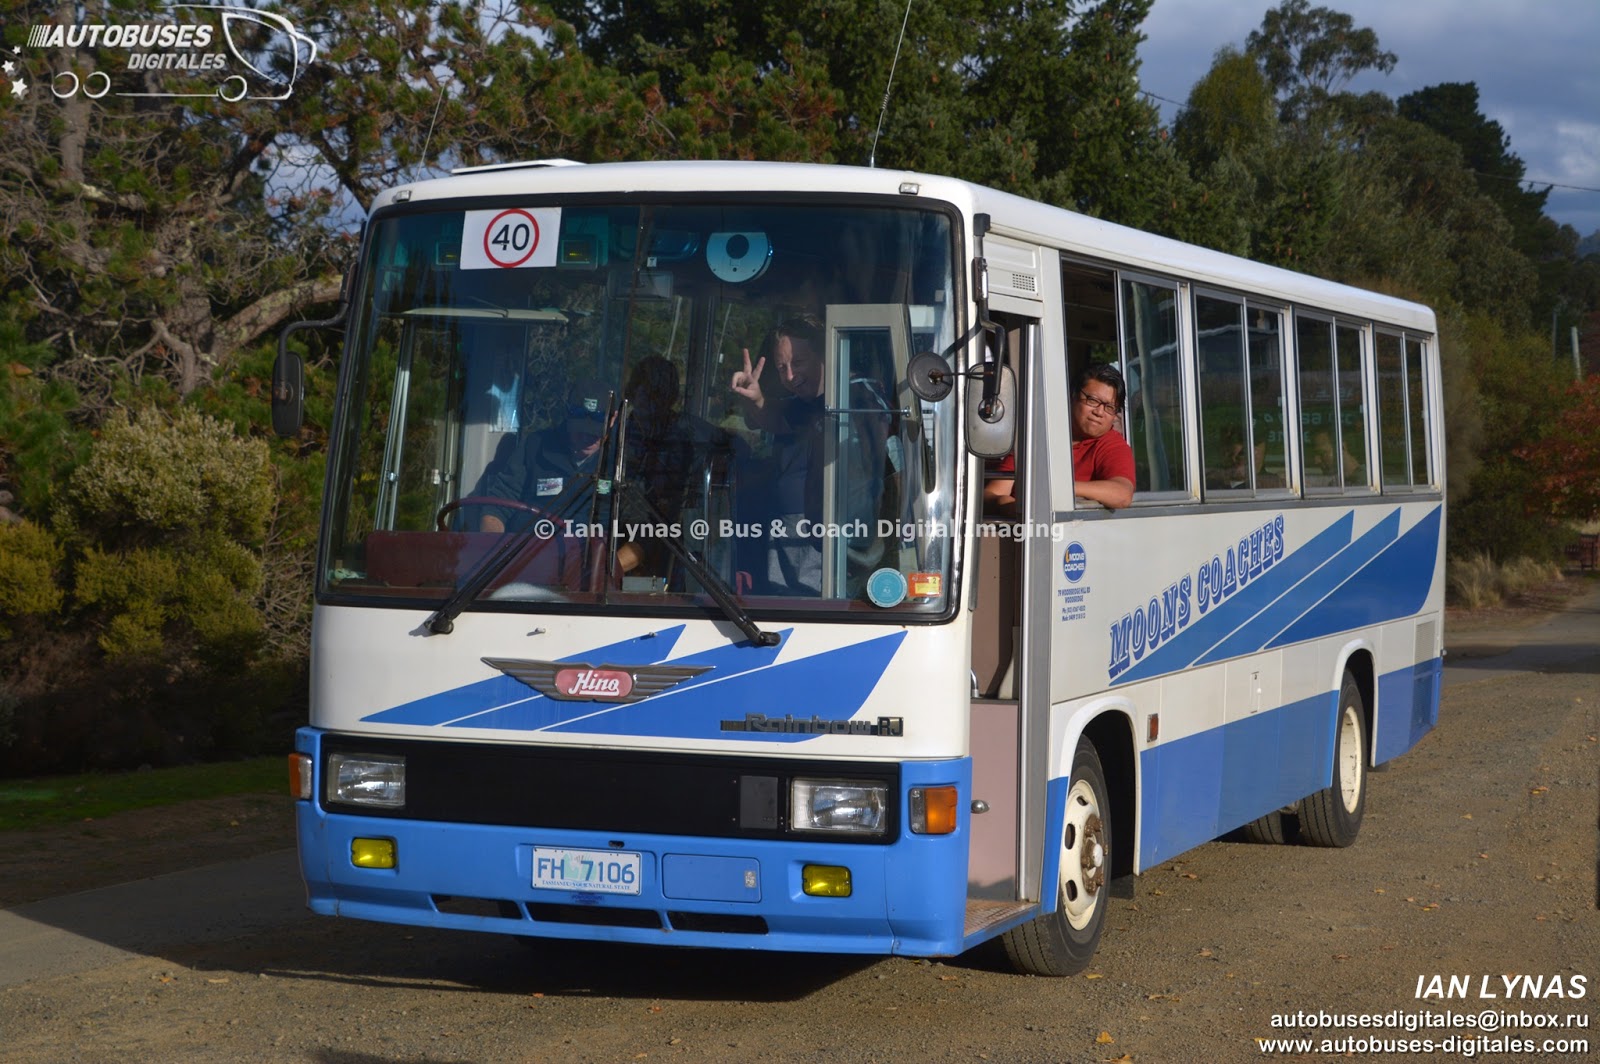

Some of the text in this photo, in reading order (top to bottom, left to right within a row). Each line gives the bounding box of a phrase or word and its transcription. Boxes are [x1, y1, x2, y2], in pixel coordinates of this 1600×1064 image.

[491, 223, 531, 251] 40
[1109, 513, 1285, 679] MOONS COACHES
[568, 670, 620, 696] Hino
[745, 712, 904, 737] Rainbow RJ
[537, 857, 635, 884] FH 7106
